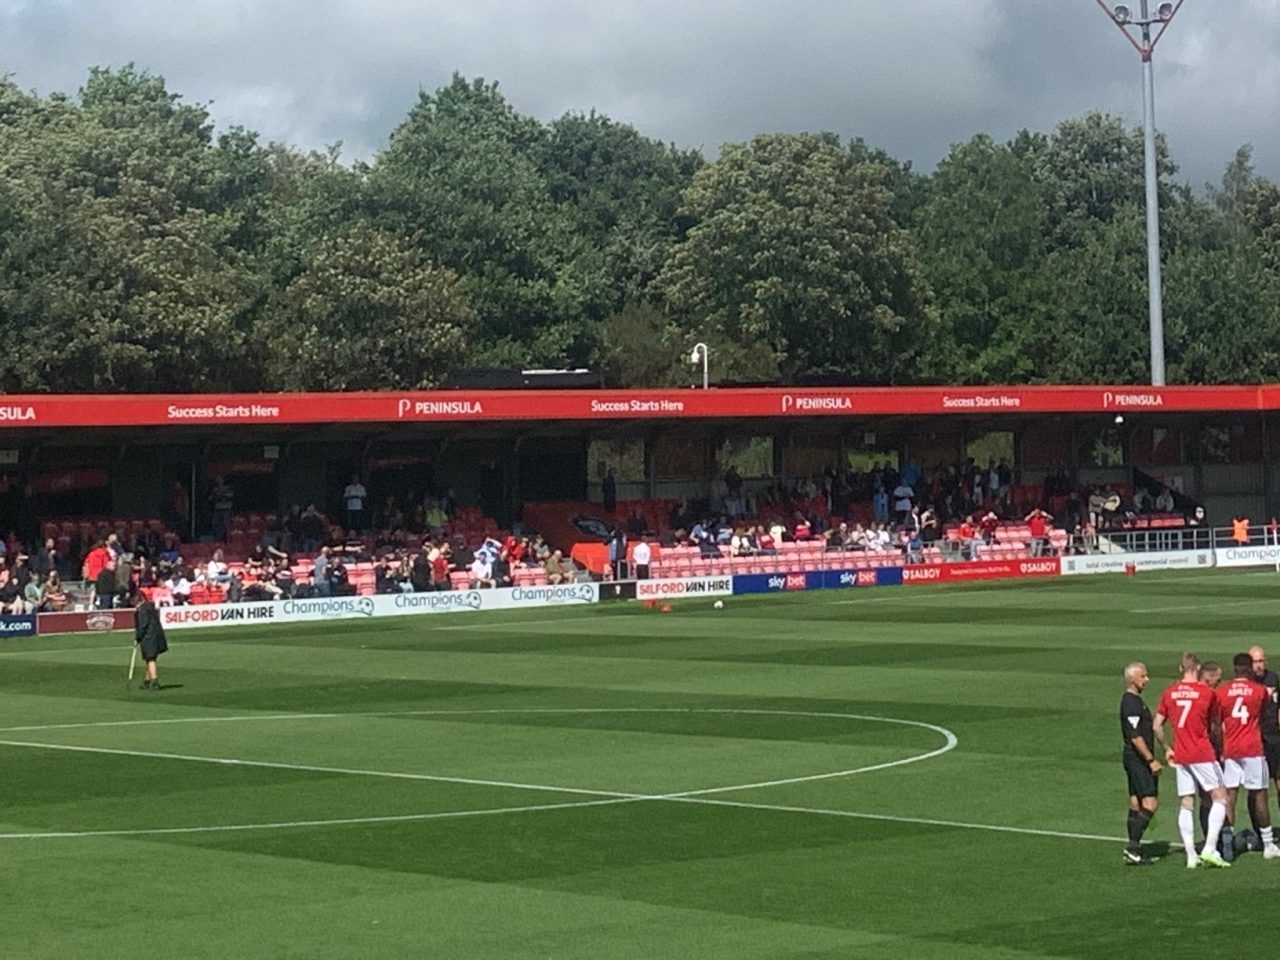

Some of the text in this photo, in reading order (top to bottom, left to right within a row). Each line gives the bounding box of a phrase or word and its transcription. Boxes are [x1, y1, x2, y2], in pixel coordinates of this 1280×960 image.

[591, 400, 683, 411] Success Starts Here
[796, 398, 852, 409] PENINSULA
[943, 397, 1020, 407] Success Starts Here
[1115, 395, 1162, 405] PENINSULA
[0, 407, 35, 420] SULA
[168, 405, 279, 418] Success Starts Here
[416, 401, 482, 413] PENINSULA
[910, 568, 940, 580] SALBOY
[1026, 562, 1056, 573] SALBOY
[768, 574, 805, 589] sky bet
[840, 571, 875, 585] sky bet
[512, 585, 577, 602] Champions
[640, 580, 730, 595] SALFORD VAN HIRE
[395, 591, 463, 608] Champions
[283, 598, 354, 615] Champions
[165, 606, 274, 624] SALFORD VAN HIRE
[1176, 700, 1193, 728] 7
[1232, 696, 1249, 725] 4
